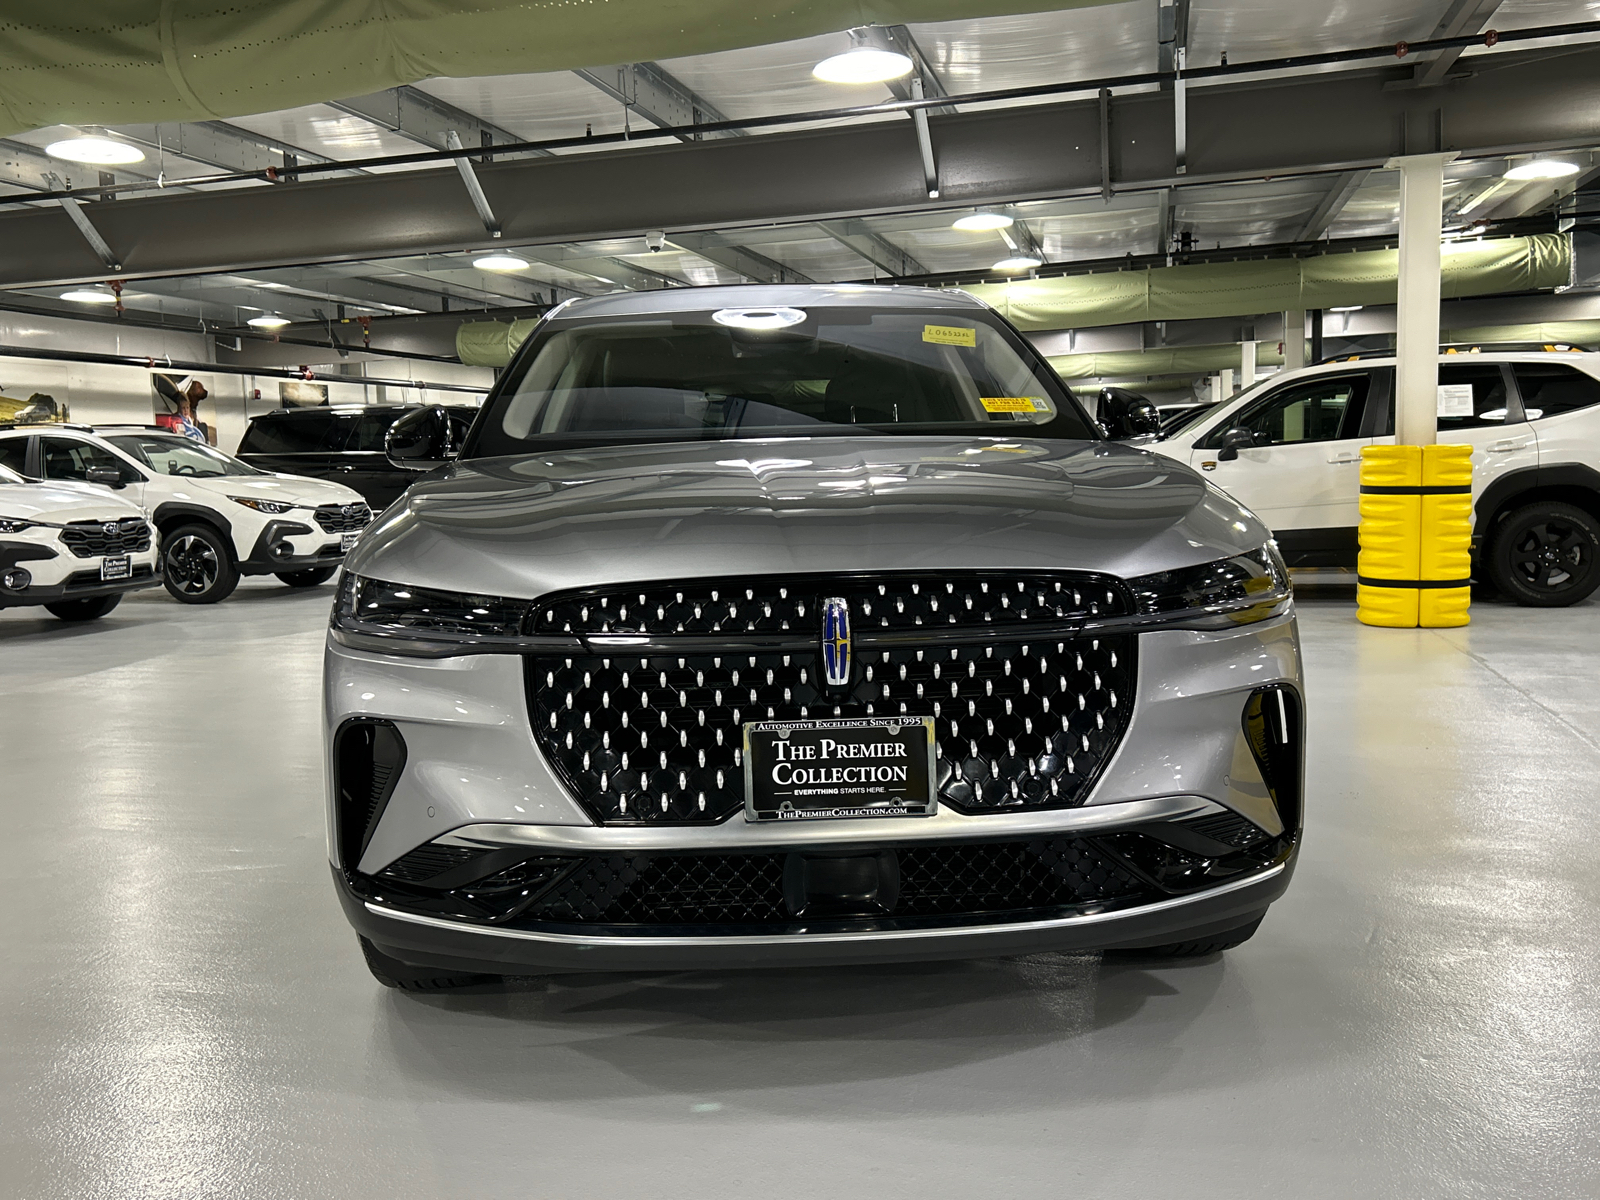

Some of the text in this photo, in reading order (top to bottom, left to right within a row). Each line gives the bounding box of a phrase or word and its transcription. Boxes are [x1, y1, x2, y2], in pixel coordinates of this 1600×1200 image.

[758, 722, 813, 730] AUTOMOTIVE
[772, 739, 908, 760] THE PREMIER
[772, 763, 908, 785] COLLECTION
